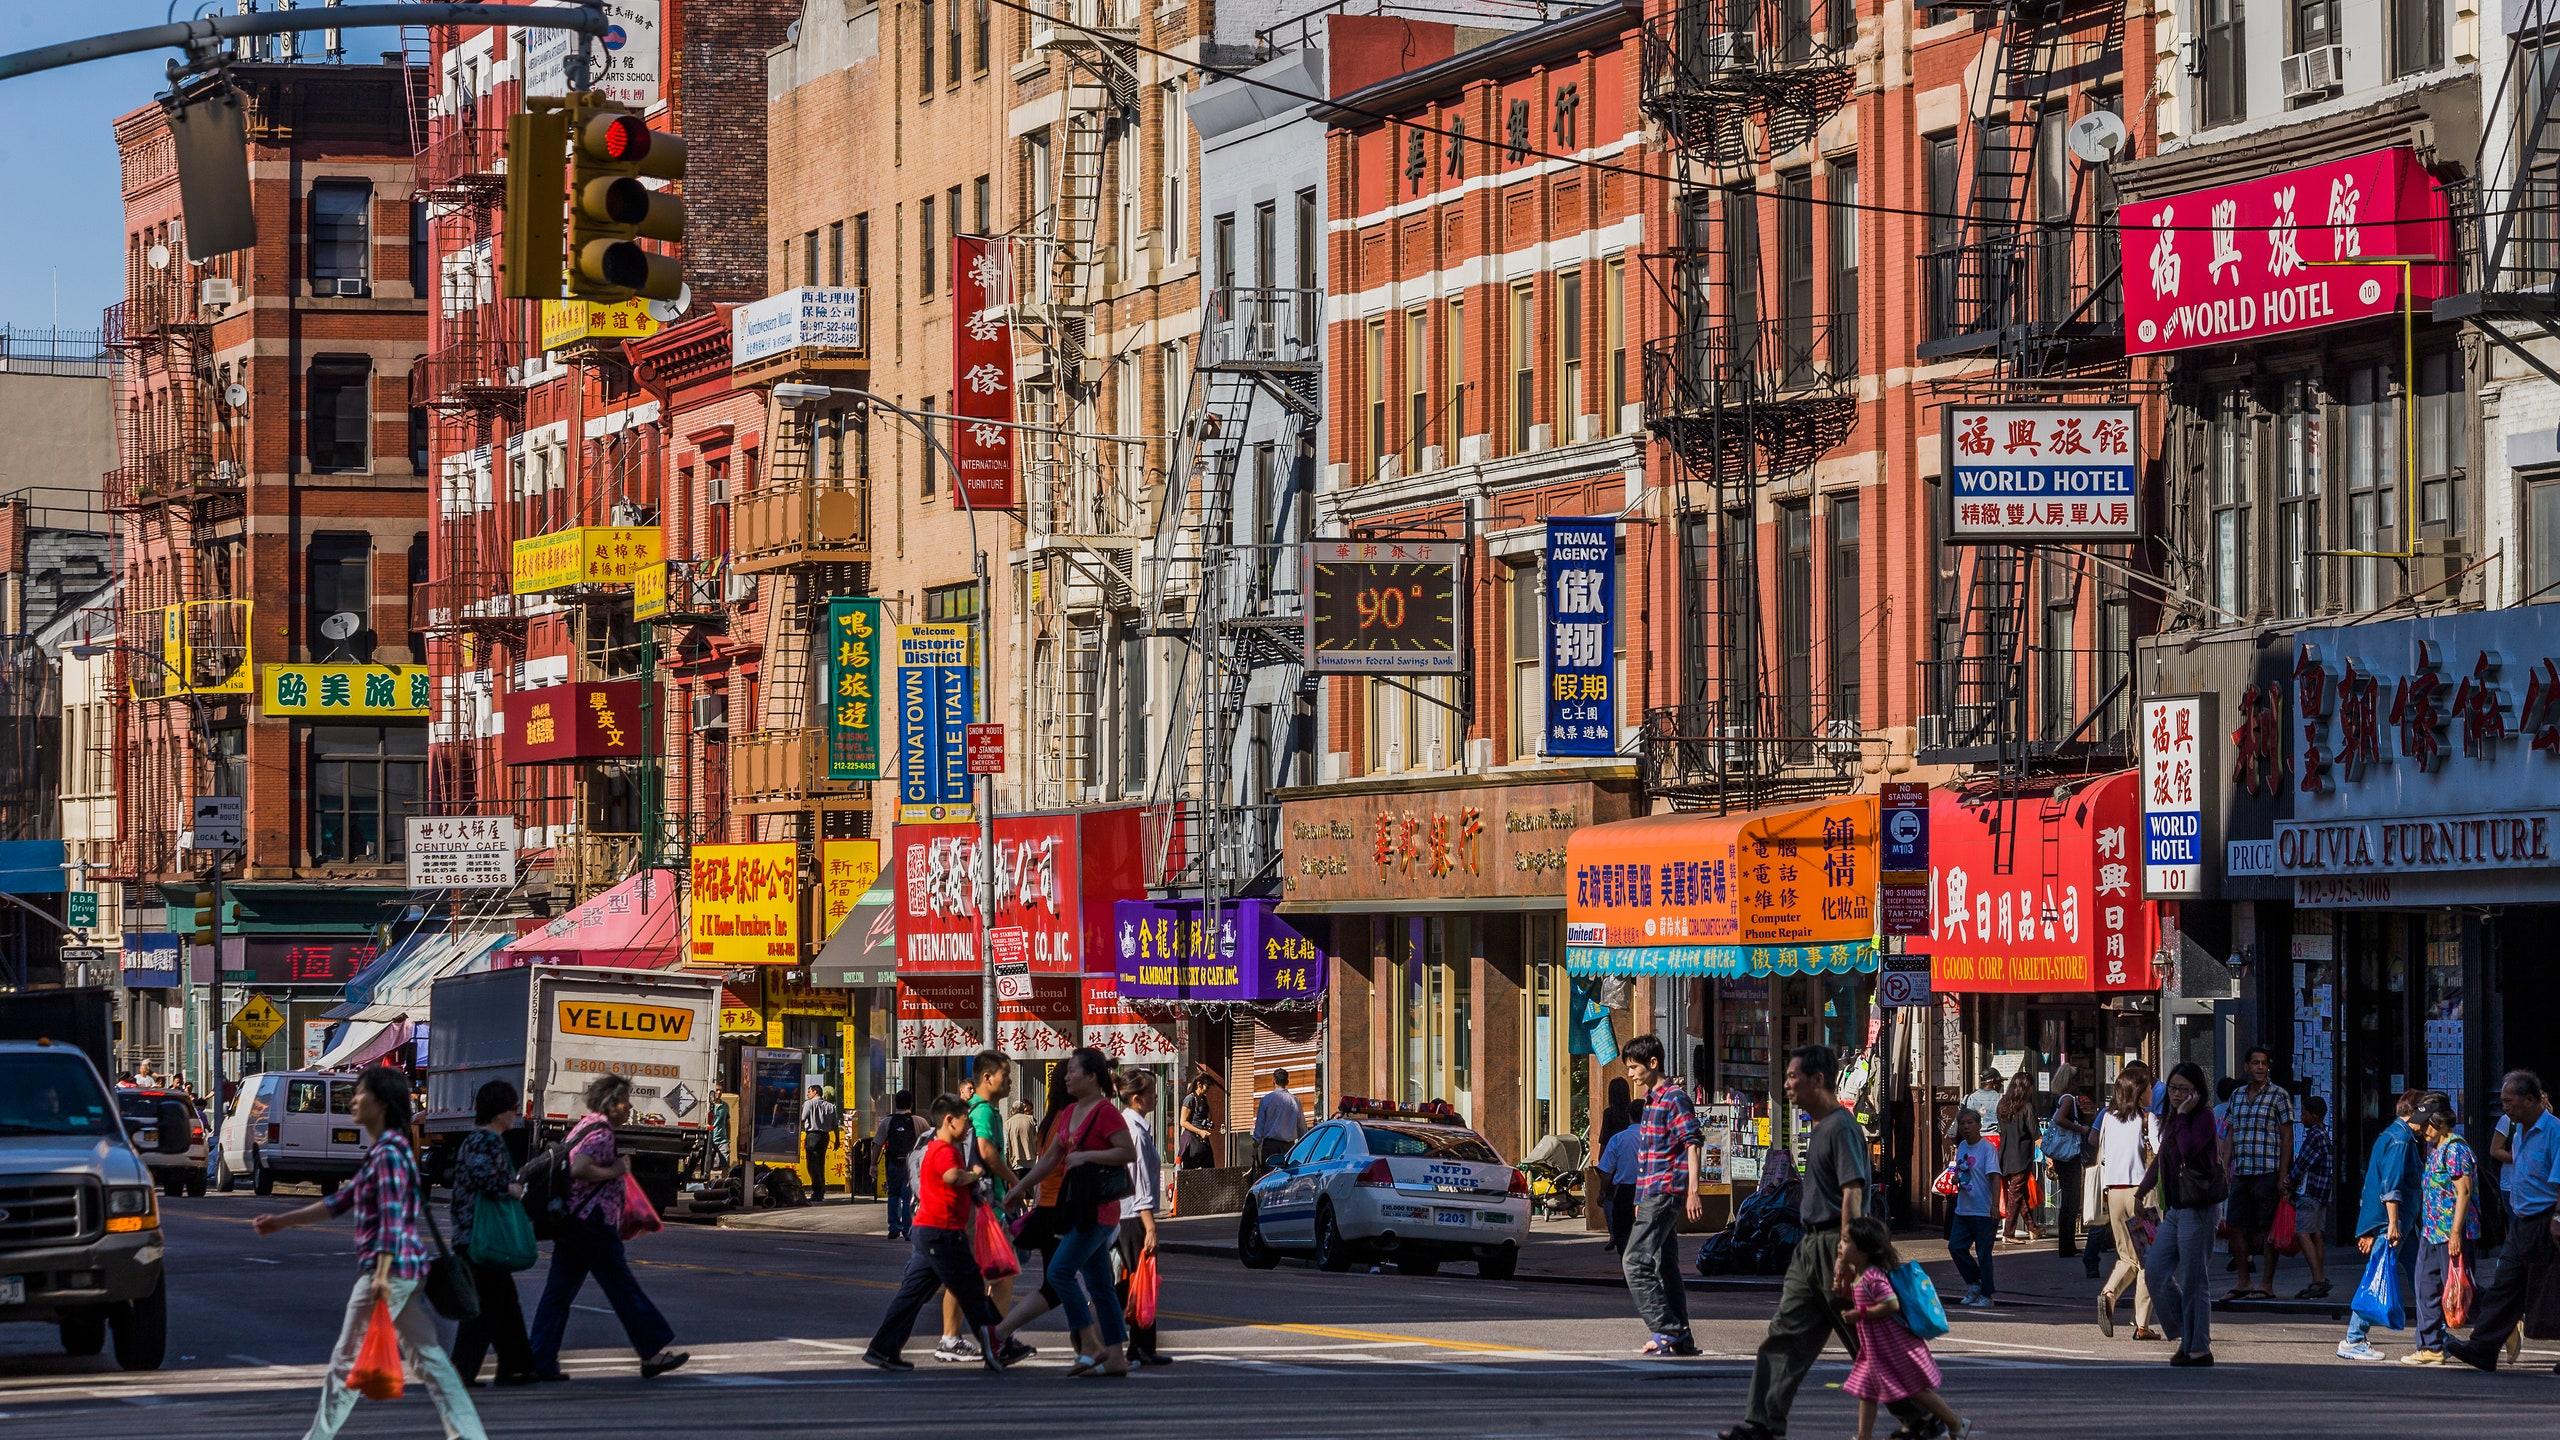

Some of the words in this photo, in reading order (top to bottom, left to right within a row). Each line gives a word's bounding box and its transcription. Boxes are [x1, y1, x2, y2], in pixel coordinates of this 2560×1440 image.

[606, 73, 624, 81] ARTS
[626, 73, 655, 82] SCHOOL
[801, 291, 854, 304] 西北理財
[2362, 285, 2376, 299] 101
[802, 306, 854, 318] 保險公司
[2163, 307, 2179, 343] NEW
[2178, 295, 2256, 339] WORLD
[2264, 281, 2334, 326] HOTEL
[591, 312, 650, 330] 聯誼會
[2141, 325, 2153, 338] 101
[1957, 415, 2129, 457] 福興旅館
[962, 458, 1009, 470] INTERNATIONAL
[967, 479, 1004, 490] FURNITURE
[1958, 470, 2046, 492] WORLD
[2054, 470, 2129, 492] HOTEL
[1555, 532, 1606, 545] TRAVAL
[1336, 544, 1433, 560] 華邦銀行
[1553, 547, 1608, 561] AGENCY
[912, 627, 956, 636] Welcome
[902, 639, 965, 650] Historic
[905, 651, 962, 664] District
[1316, 656, 1362, 666] Chinatown
[1366, 656, 1394, 666] Federal
[1397, 656, 1429, 668] Savings
[1433, 656, 1454, 666] Bank
[1553, 673, 1607, 701] 假期
[944, 670, 962, 726] ITALY
[1561, 706, 1599, 721] 巴士團
[906, 671, 926, 801] CHINATOWN
[987, 726, 1002, 734] ROUTE
[1553, 726, 1578, 740] 機票
[979, 745, 1003, 753] STANDING
[946, 731, 964, 799] LITTLE
[1888, 793, 1923, 801] STANDING
[2151, 815, 2197, 836] WORLD
[415, 842, 469, 851] CENTURY
[476, 841, 506, 851] CAFE
[1751, 837, 1798, 859] 電腦
[1892, 843, 1914, 855] M103
[2152, 839, 2193, 860] HOTEL
[2278, 825, 2375, 869] OLIVIA
[2382, 817, 2548, 866] FURNITURE
[2233, 844, 2272, 870] PRICE
[1752, 863, 1799, 885] 電話
[2162, 869, 2185, 890] 101
[73, 895, 95, 903] F.D.R.
[1753, 888, 1800, 910] 維修
[1885, 889, 1893, 897] NO
[1897, 889, 1926, 897] STANDING
[72, 904, 95, 913] Drive
[714, 914, 734, 936] Home
[735, 913, 771, 937] Furniture
[775, 914, 788, 936] Inc
[1751, 912, 1801, 926] Computer
[1568, 926, 1604, 942] UnitedEX
[1745, 927, 1776, 939] Phone
[1778, 926, 1813, 941] Repair
[908, 933, 975, 962] INTERNATIONAL
[1265, 937, 1316, 960] 金龍船
[1139, 966, 1172, 986] KAMBOAT
[1173, 966, 1200, 986] BAKERY
[1207, 966, 1224, 986] CAFE
[1225, 965, 1239, 985] INC.
[1943, 956, 1974, 980] GOODS
[1978, 956, 2005, 980] CORP.
[2009, 955, 2088, 986] (VARIETY-STORE)
[1275, 968, 1308, 991] 餅屋
[905, 985, 975, 997] International
[902, 1000, 954, 1011] Furniture
[960, 1000, 978, 1011] Co.
[997, 1001, 1047, 1013] urniture
[1053, 1002, 1071, 1013] Co.
[566, 1008, 686, 1035] YELLOW
[724, 1010, 757, 1029] 市場
[768, 1051, 791, 1059] Phone
[1429, 1164, 1472, 1176] NYPD
[1422, 1174, 1479, 1188] POLICE
[1438, 1212, 1467, 1225] 2203
